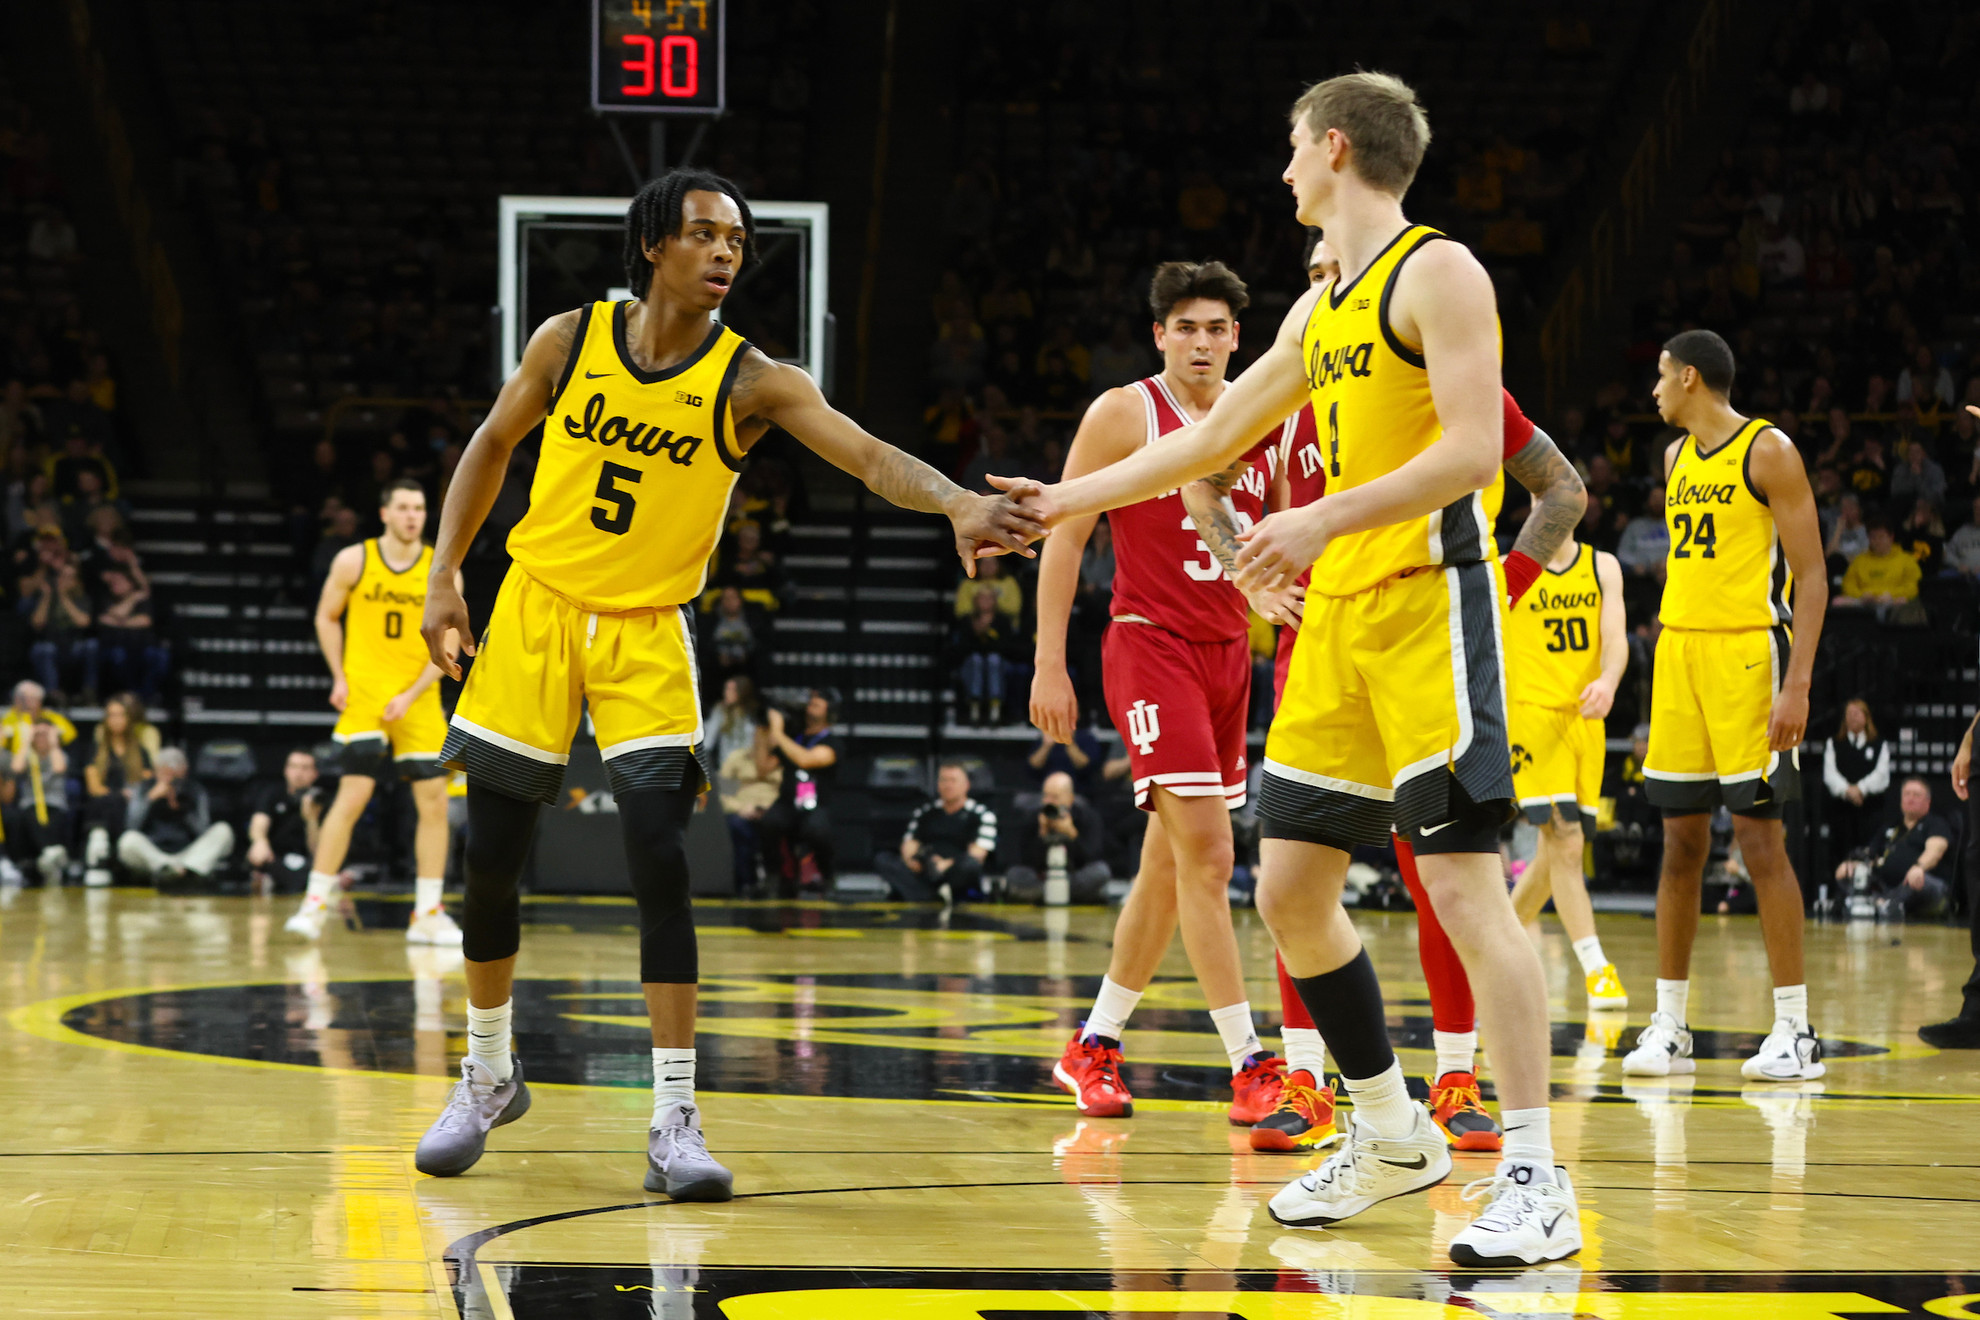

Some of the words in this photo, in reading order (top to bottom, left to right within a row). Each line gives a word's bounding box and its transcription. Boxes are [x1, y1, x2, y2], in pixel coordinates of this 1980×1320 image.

[621, 34, 698, 97] 30
[564, 392, 704, 467] Iowa
[590, 460, 643, 535] 5
[1668, 475, 1737, 507] Iowa
[1673, 512, 1716, 559] 24
[1529, 587, 1597, 613] Iowa
[385, 611, 403, 639] 0
[1543, 617, 1590, 653] 30
